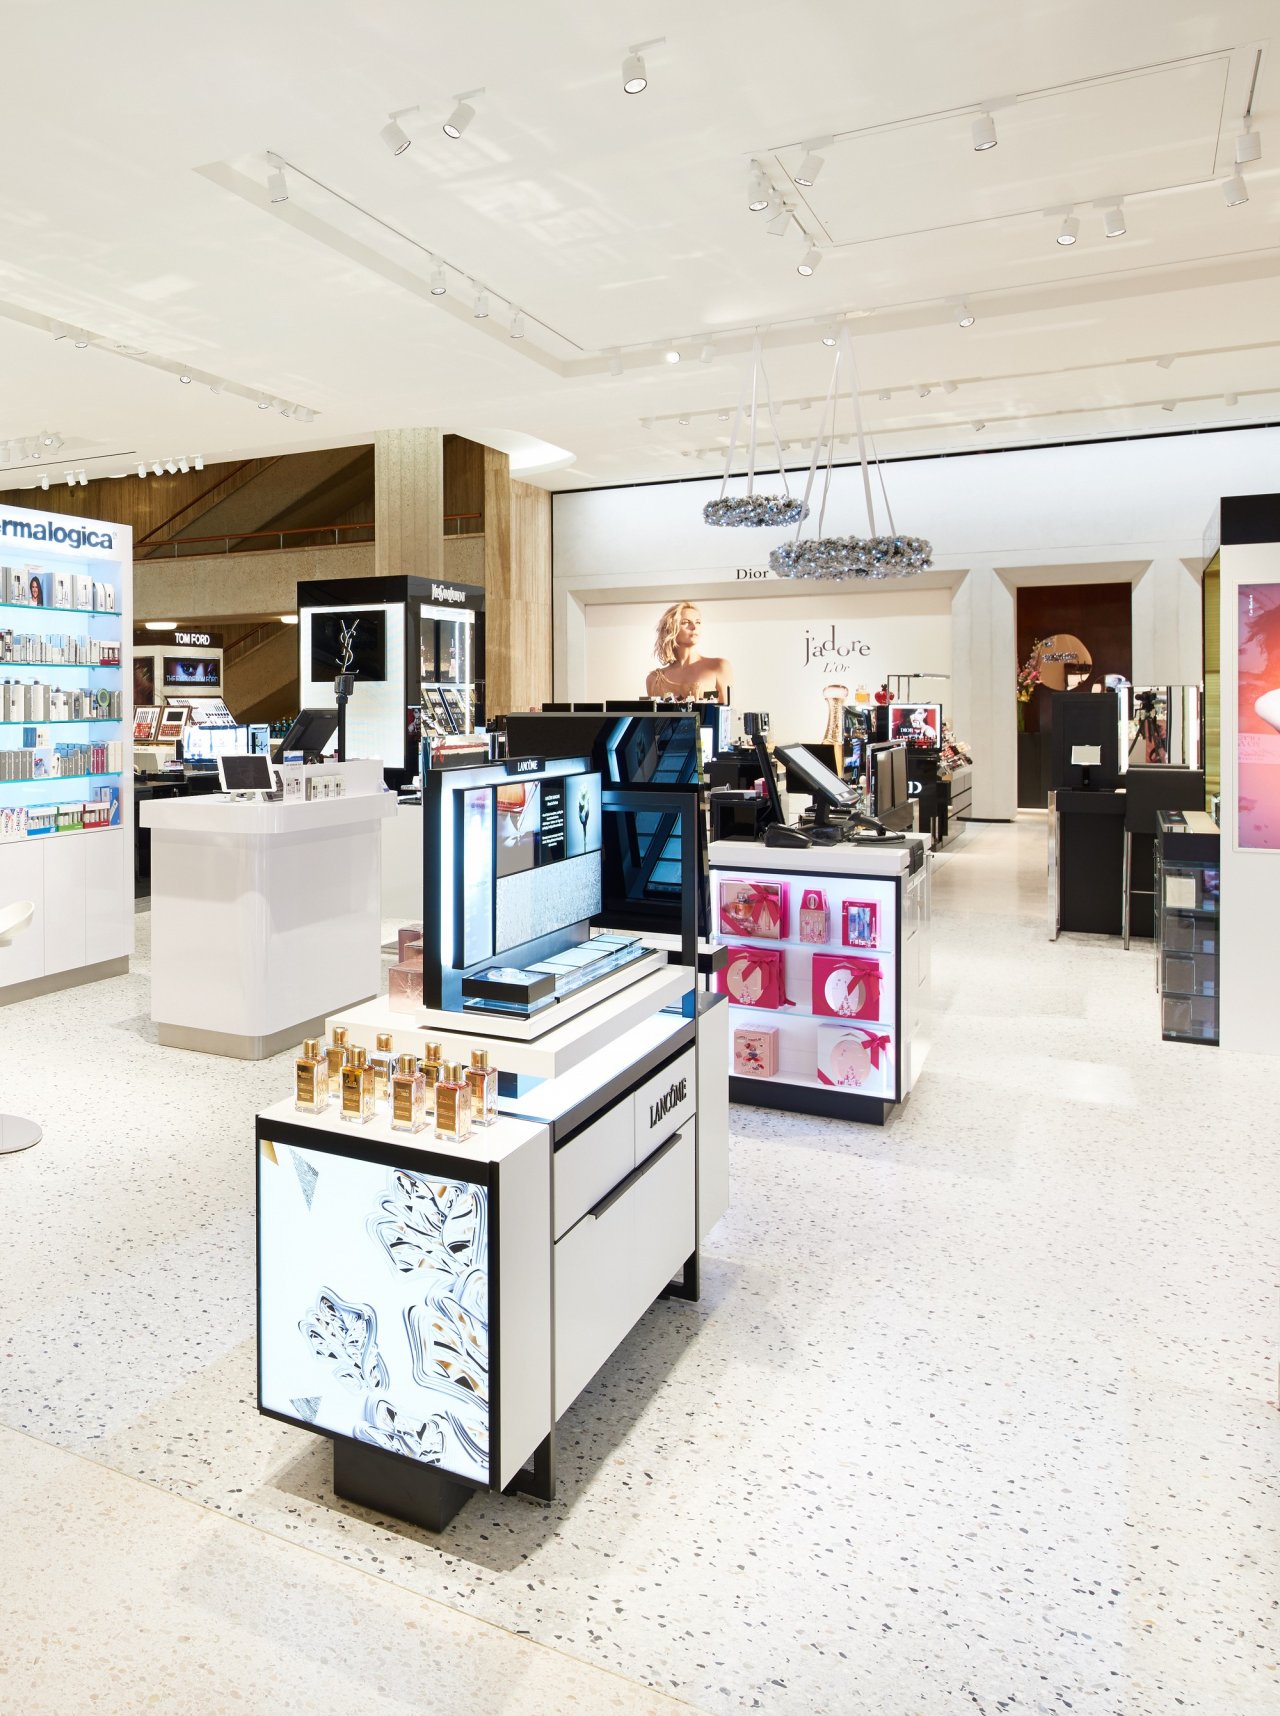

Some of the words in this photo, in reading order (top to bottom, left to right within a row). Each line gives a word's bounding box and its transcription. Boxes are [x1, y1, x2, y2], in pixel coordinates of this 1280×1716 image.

[736, 568, 769, 580] Dior
[174, 633, 191, 644] TOM
[191, 634, 211, 645] FORD
[803, 624, 871, 667] j'adore
[823, 661, 851, 673] L'Or
[517, 759, 538, 772] LANCÔME
[649, 1077, 687, 1129] LANCÔME
